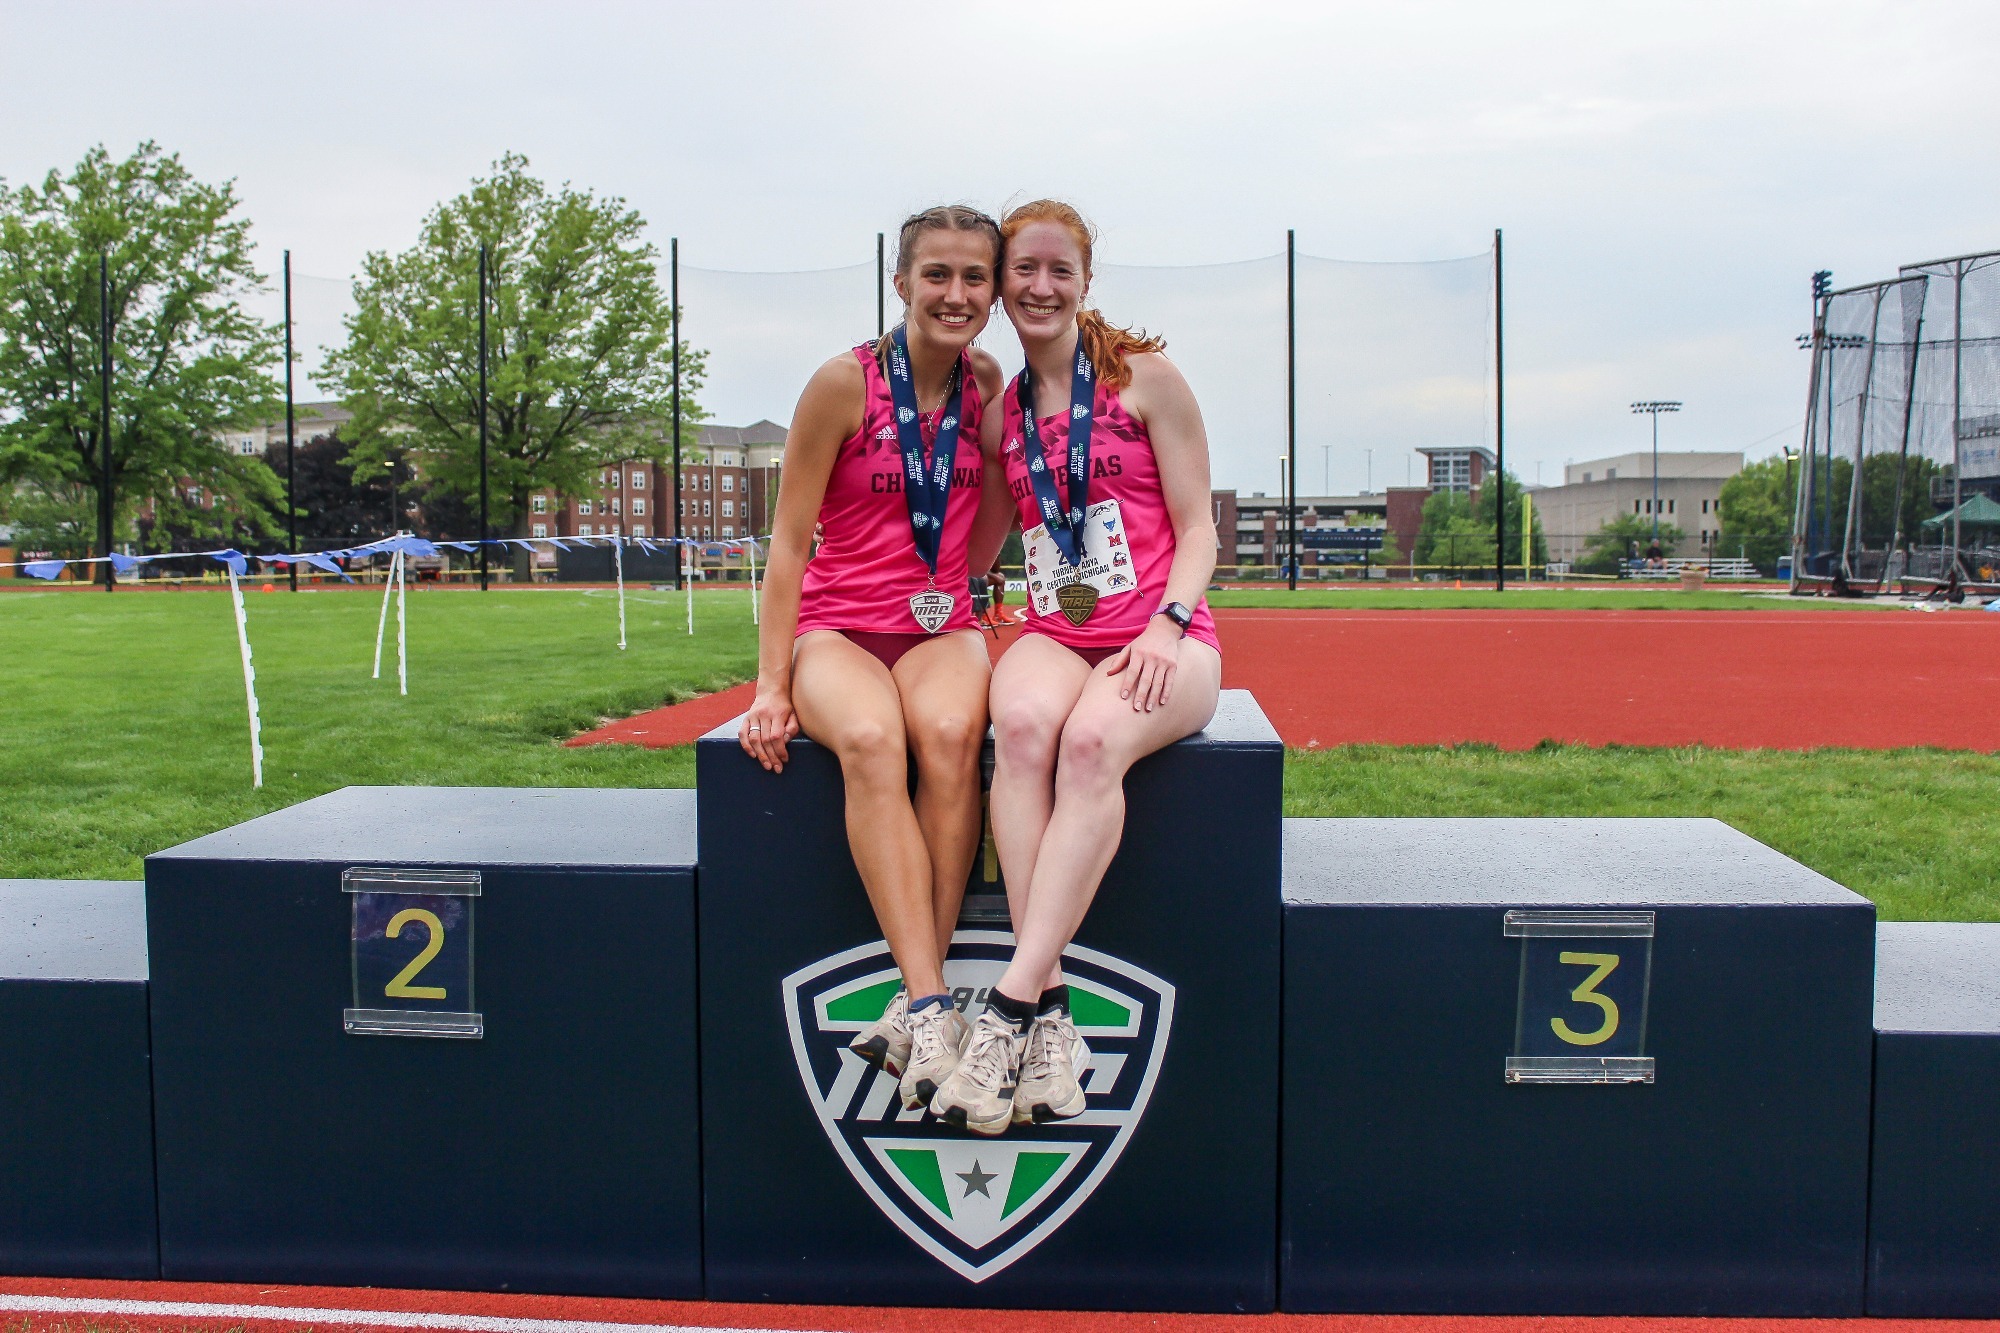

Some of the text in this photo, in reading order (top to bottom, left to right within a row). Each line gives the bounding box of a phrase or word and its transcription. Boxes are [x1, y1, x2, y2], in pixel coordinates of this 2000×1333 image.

[1081, 557, 1099, 570] ANYA
[385, 908, 447, 1000] 2
[1551, 951, 1620, 1046] 3
